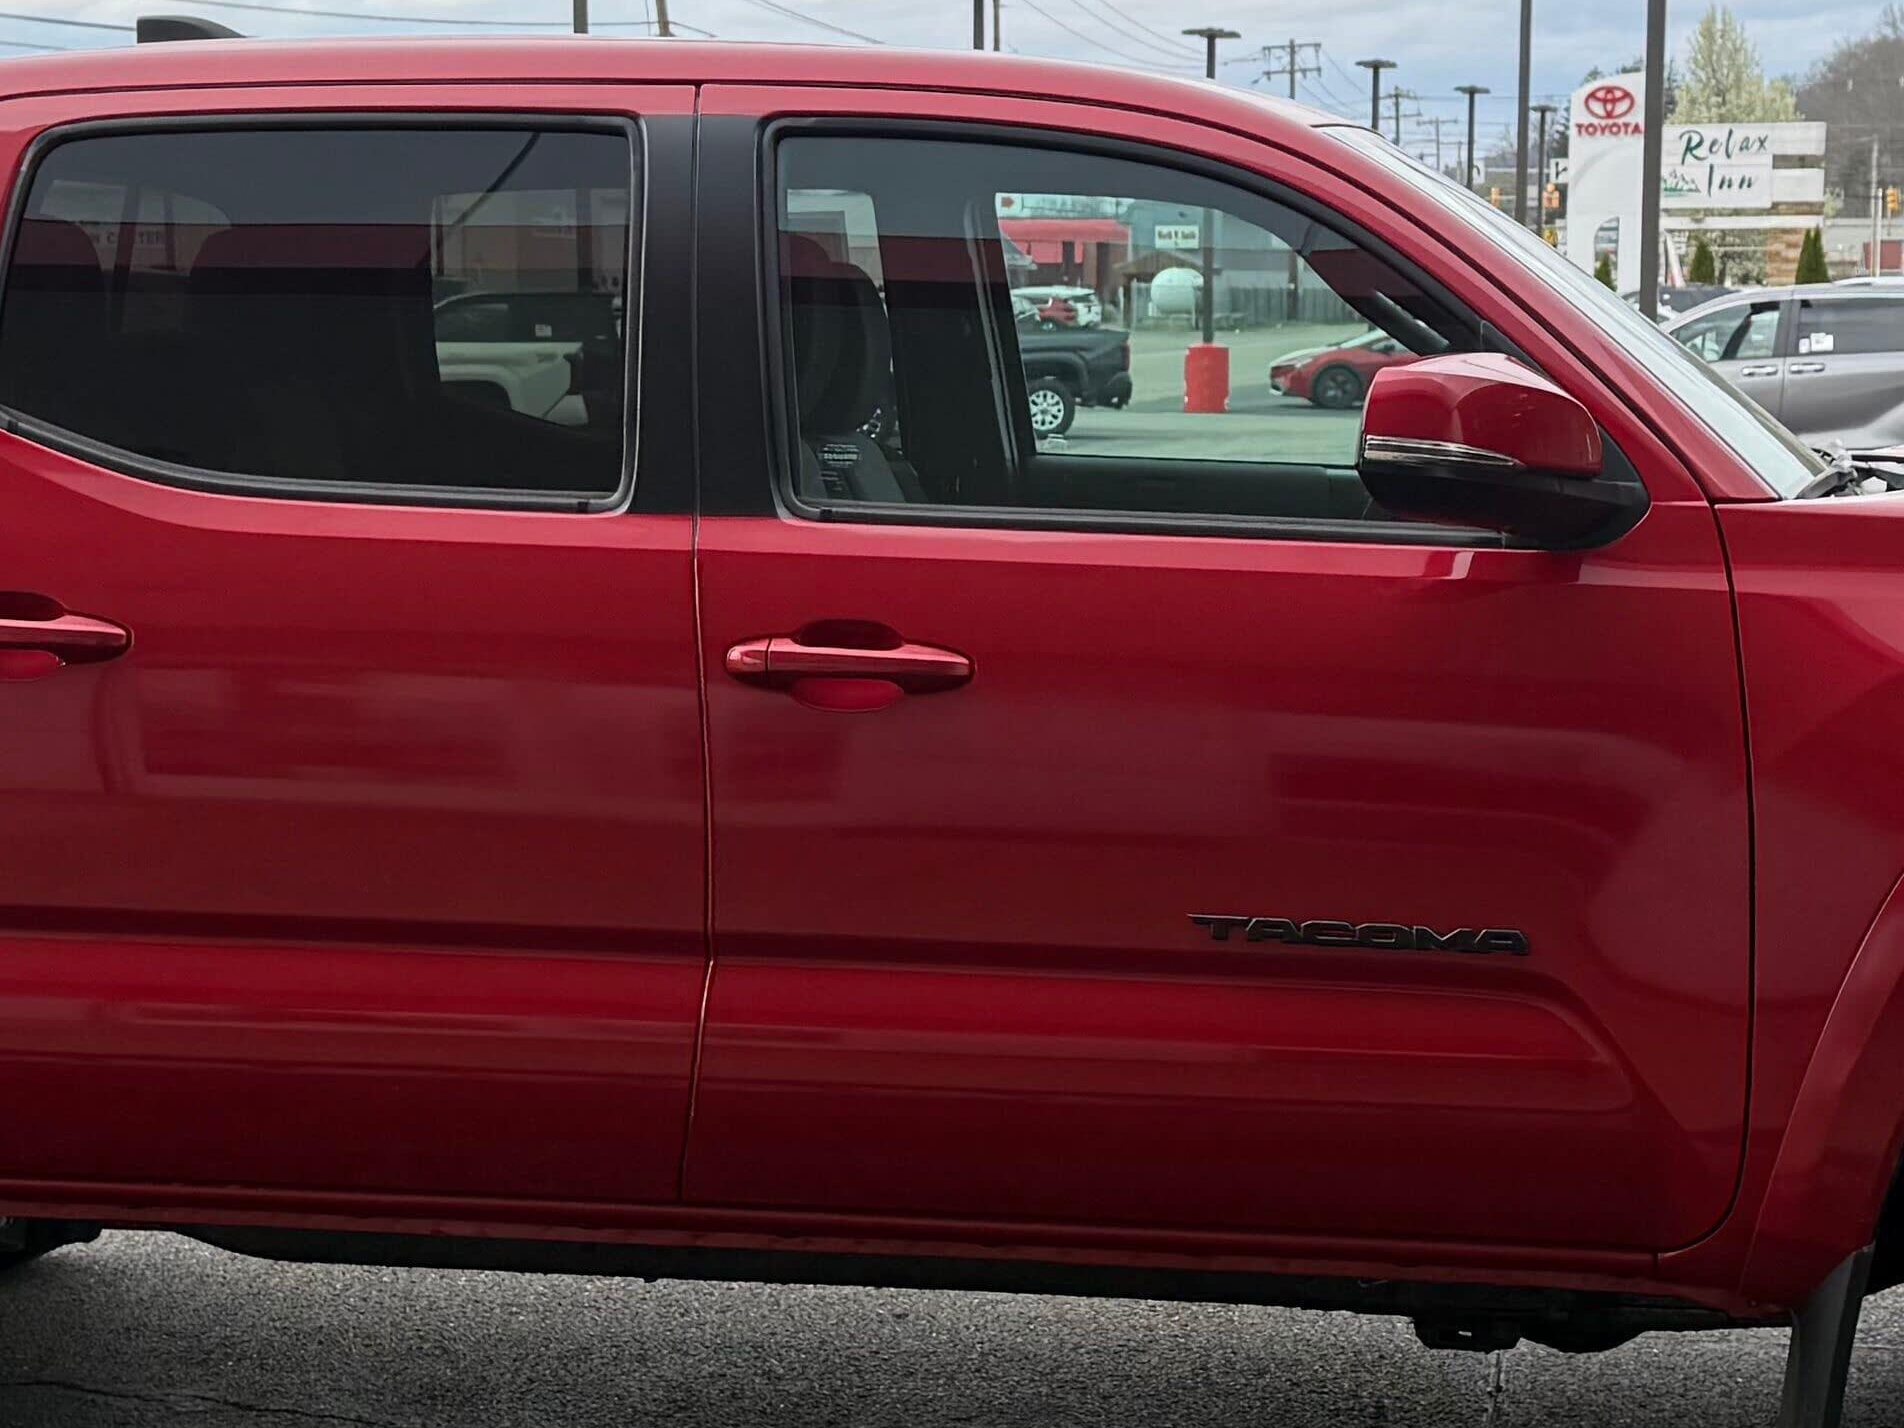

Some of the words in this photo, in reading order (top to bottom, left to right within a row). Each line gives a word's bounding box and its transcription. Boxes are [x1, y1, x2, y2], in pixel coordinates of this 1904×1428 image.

[1575, 122, 1642, 136] TOYOTA
[1678, 127, 1769, 166] Relax
[1707, 163, 1756, 197] Inn
[1186, 913, 1531, 956] TACOMA
